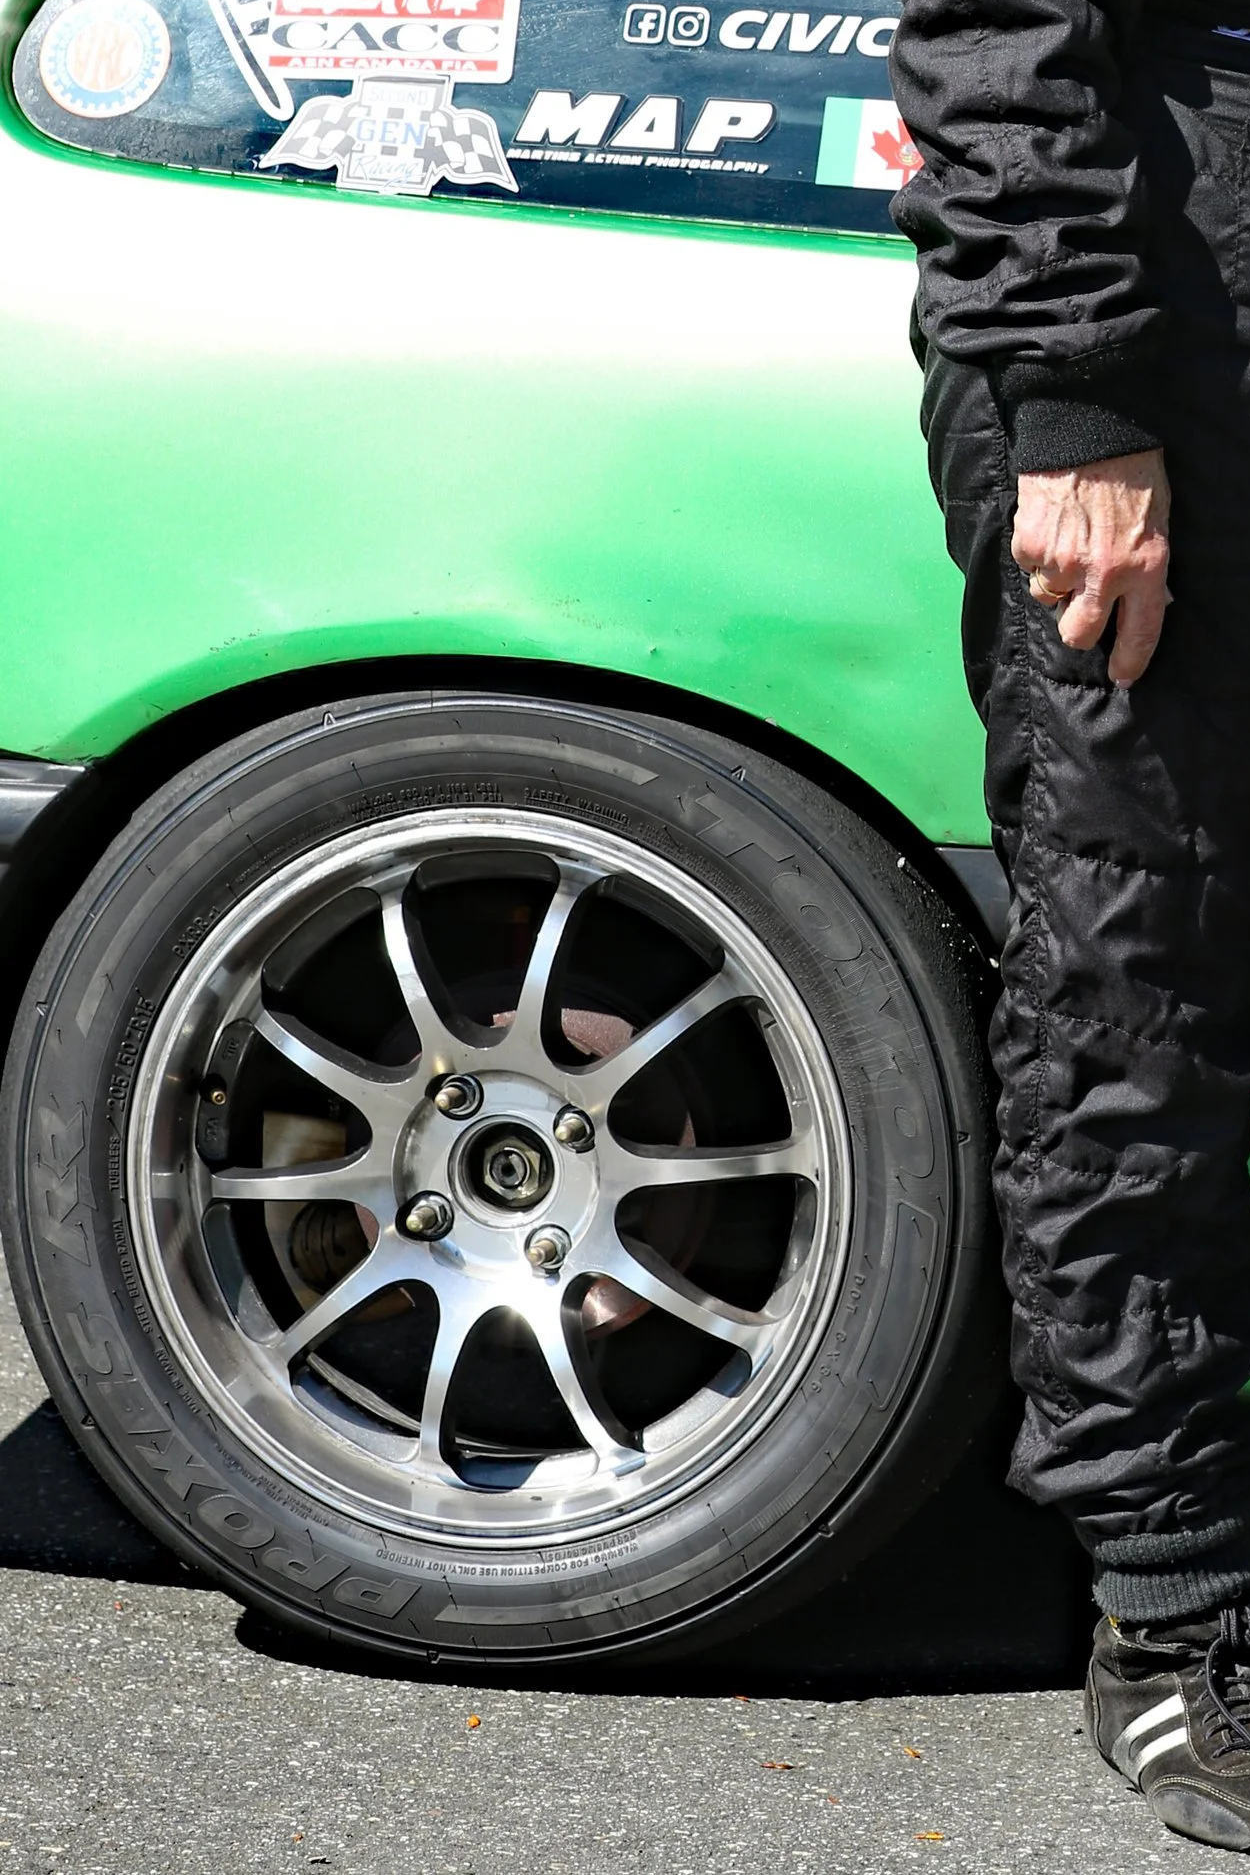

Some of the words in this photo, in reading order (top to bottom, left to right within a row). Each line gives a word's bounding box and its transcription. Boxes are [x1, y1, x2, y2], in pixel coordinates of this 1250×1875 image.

[272, 21, 499, 53] CACC
[287, 56, 335, 68] ASN
[338, 57, 436, 71] CANADA
[440, 60, 479, 71] FIA
[356, 118, 426, 146] GEN
[513, 88, 777, 155] MAP
[351, 154, 420, 189] Racing
[506, 147, 581, 162] MARTINS
[583, 152, 643, 166] ACTION
[645, 156, 769, 175] PHOTOGRAPHY
[107, 1134, 122, 1191] TUBELESS
[112, 1219, 128, 1255] RADIAL
[120, 1259, 139, 1298] BELTED
[134, 1302, 153, 1333] STEEL
[67, 1310, 423, 1619] PROXES
[374, 1547, 425, 1569] INTENDED
[424, 1559, 447, 1573] NOT
[478, 1566, 498, 1576] USE
[500, 1559, 568, 1578] COMPETITION
[568, 1556, 590, 1570] FOR
